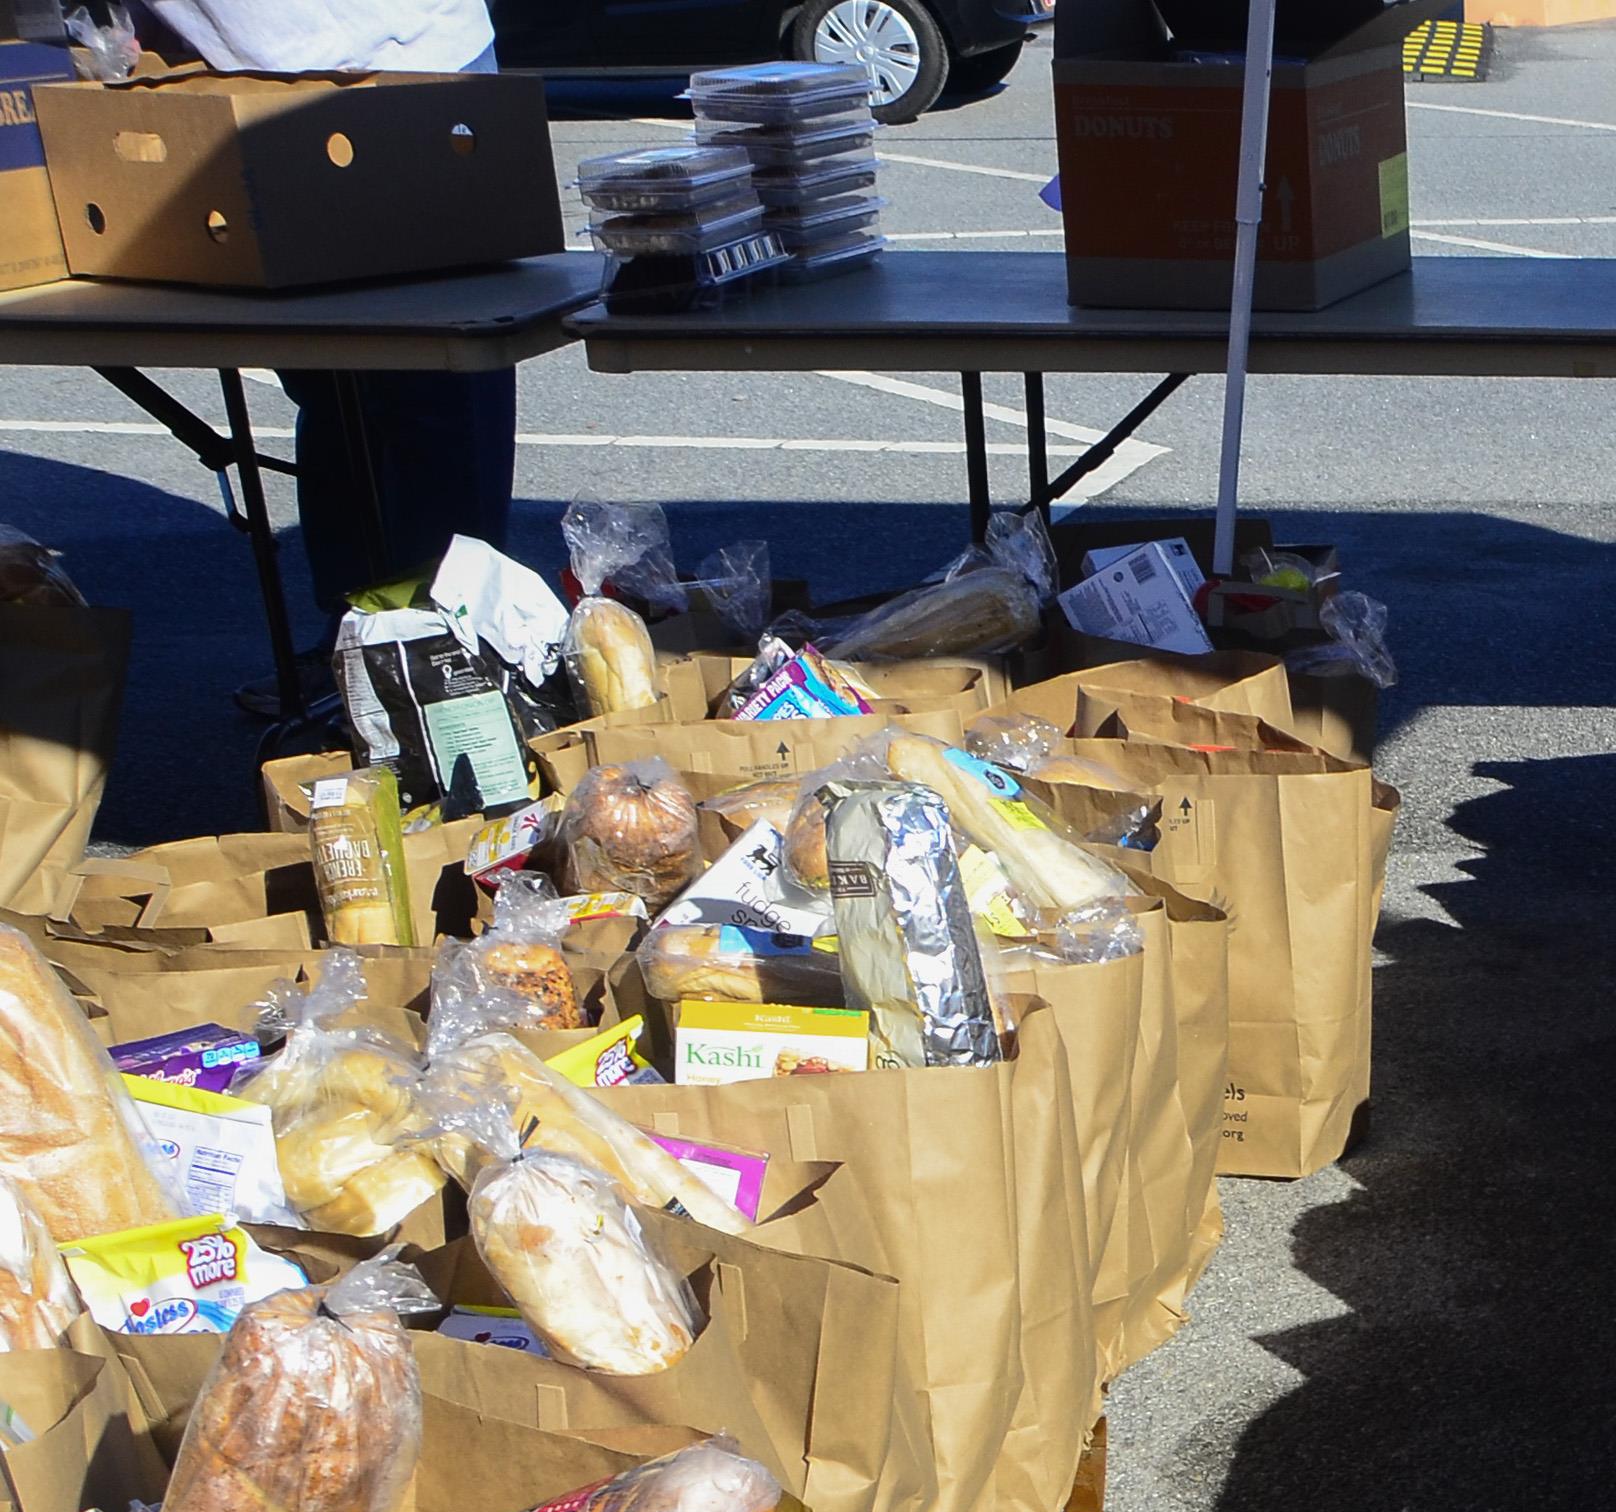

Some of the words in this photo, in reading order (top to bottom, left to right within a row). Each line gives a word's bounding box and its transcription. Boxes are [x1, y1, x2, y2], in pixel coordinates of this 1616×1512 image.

[765, 670, 793, 698] PACK
[735, 881, 792, 933] fudge
[686, 1042, 732, 1069] Kashi
[180, 1234, 236, 1267] 25%
[190, 1258, 236, 1290] more
